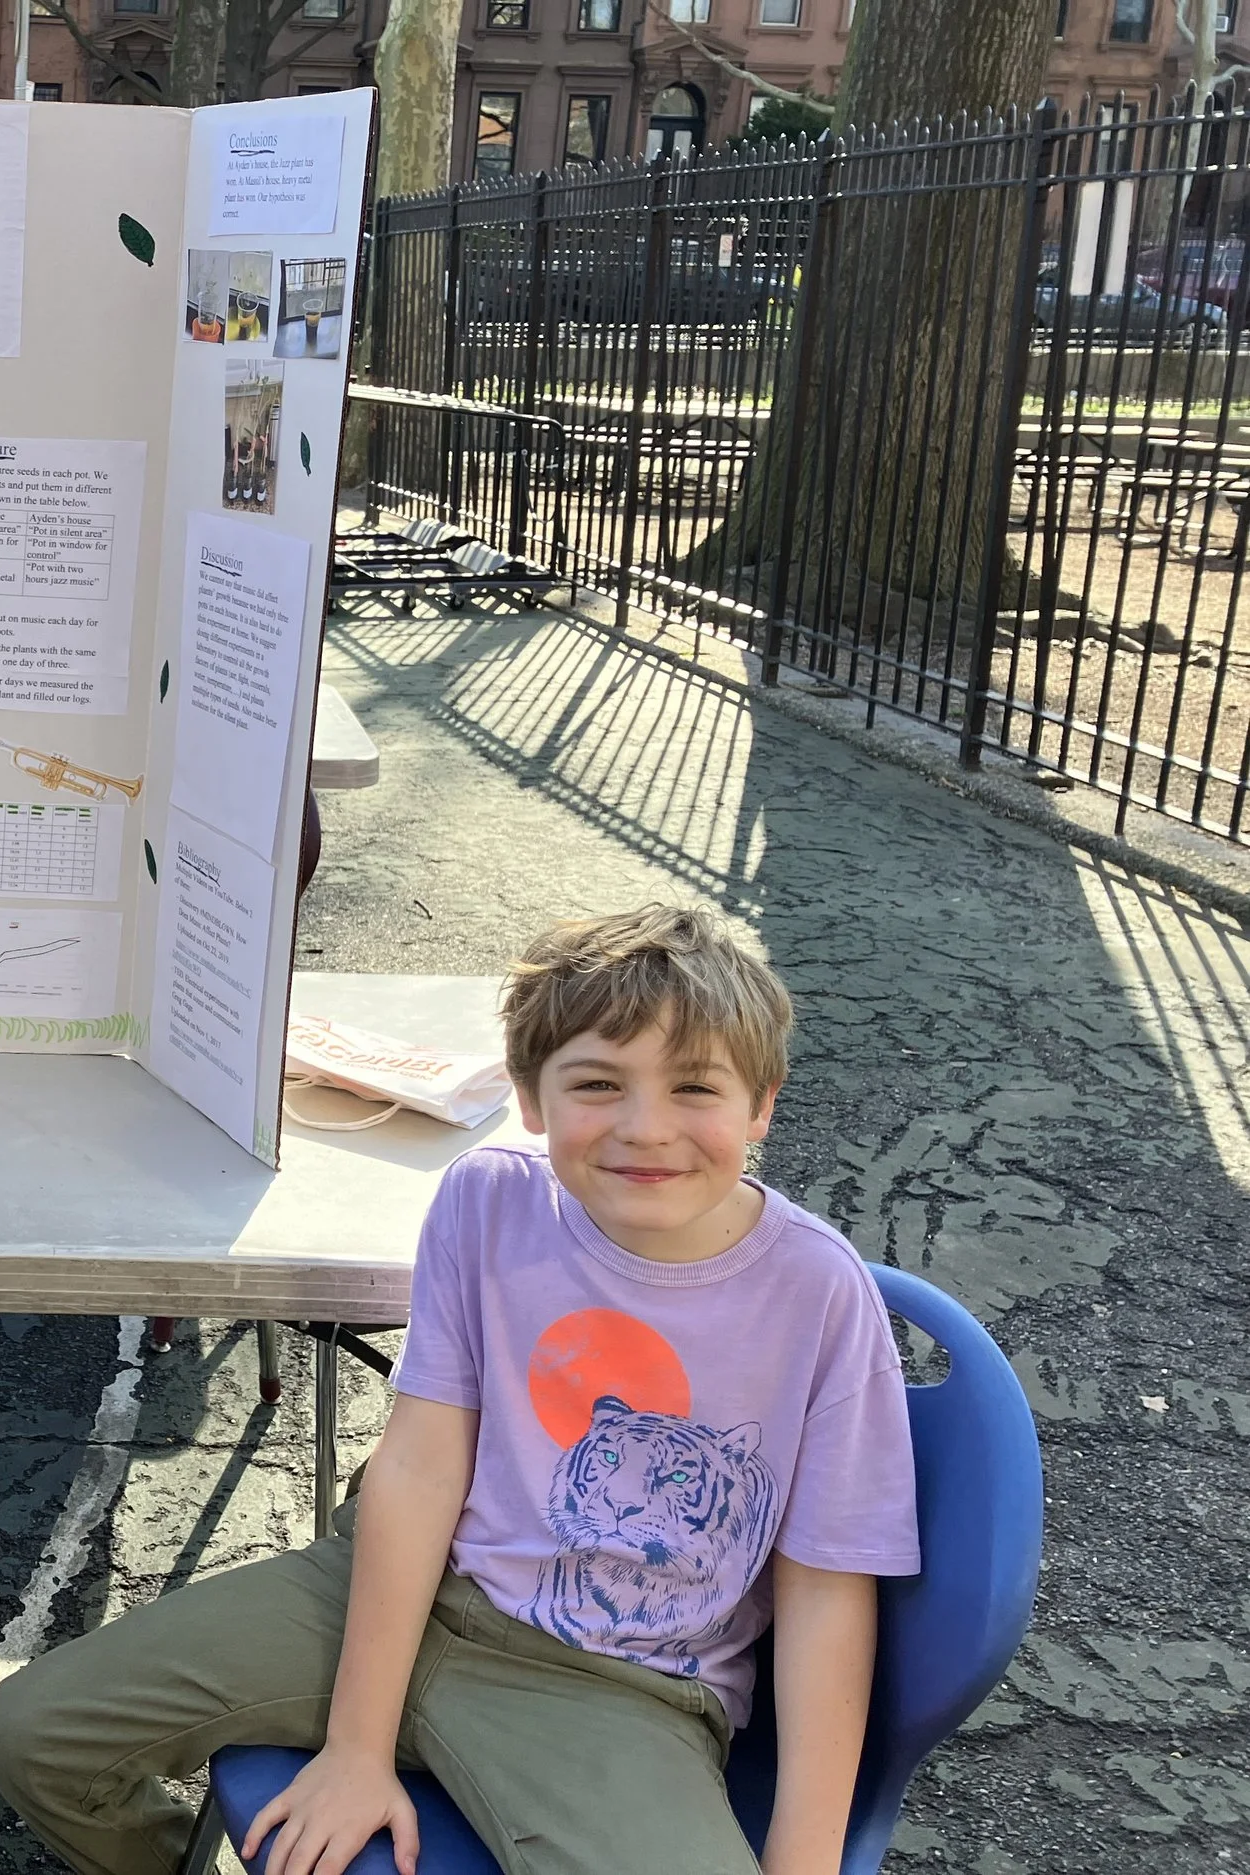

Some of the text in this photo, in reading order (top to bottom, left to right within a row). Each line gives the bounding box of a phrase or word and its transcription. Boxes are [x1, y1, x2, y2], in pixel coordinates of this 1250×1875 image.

[230, 131, 278, 148] Conclusions
[17, 468, 40, 477] seeds
[53, 469, 72, 478] each
[74, 472, 90, 481] pot.
[94, 471, 108, 480] We
[7, 481, 23, 490] and
[25, 483, 40, 492] put
[41, 482, 63, 492] them
[65, 484, 73, 492] in
[75, 484, 111, 494] different
[24, 496, 38, 505] the
[39, 497, 60, 506] table
[62, 497, 90, 507] below.
[66, 515, 91, 525] house
[59, 528, 83, 537] silent
[6, 536, 19, 546] for
[59, 541, 92, 549] window
[95, 541, 108, 550] for
[201, 547, 243, 571] Discussion
[47, 564, 66, 573] with
[68, 566, 84, 574] two
[25, 575, 49, 584] hours
[49, 578, 68, 586] jazz
[177, 841, 221, 880] Bibliography
